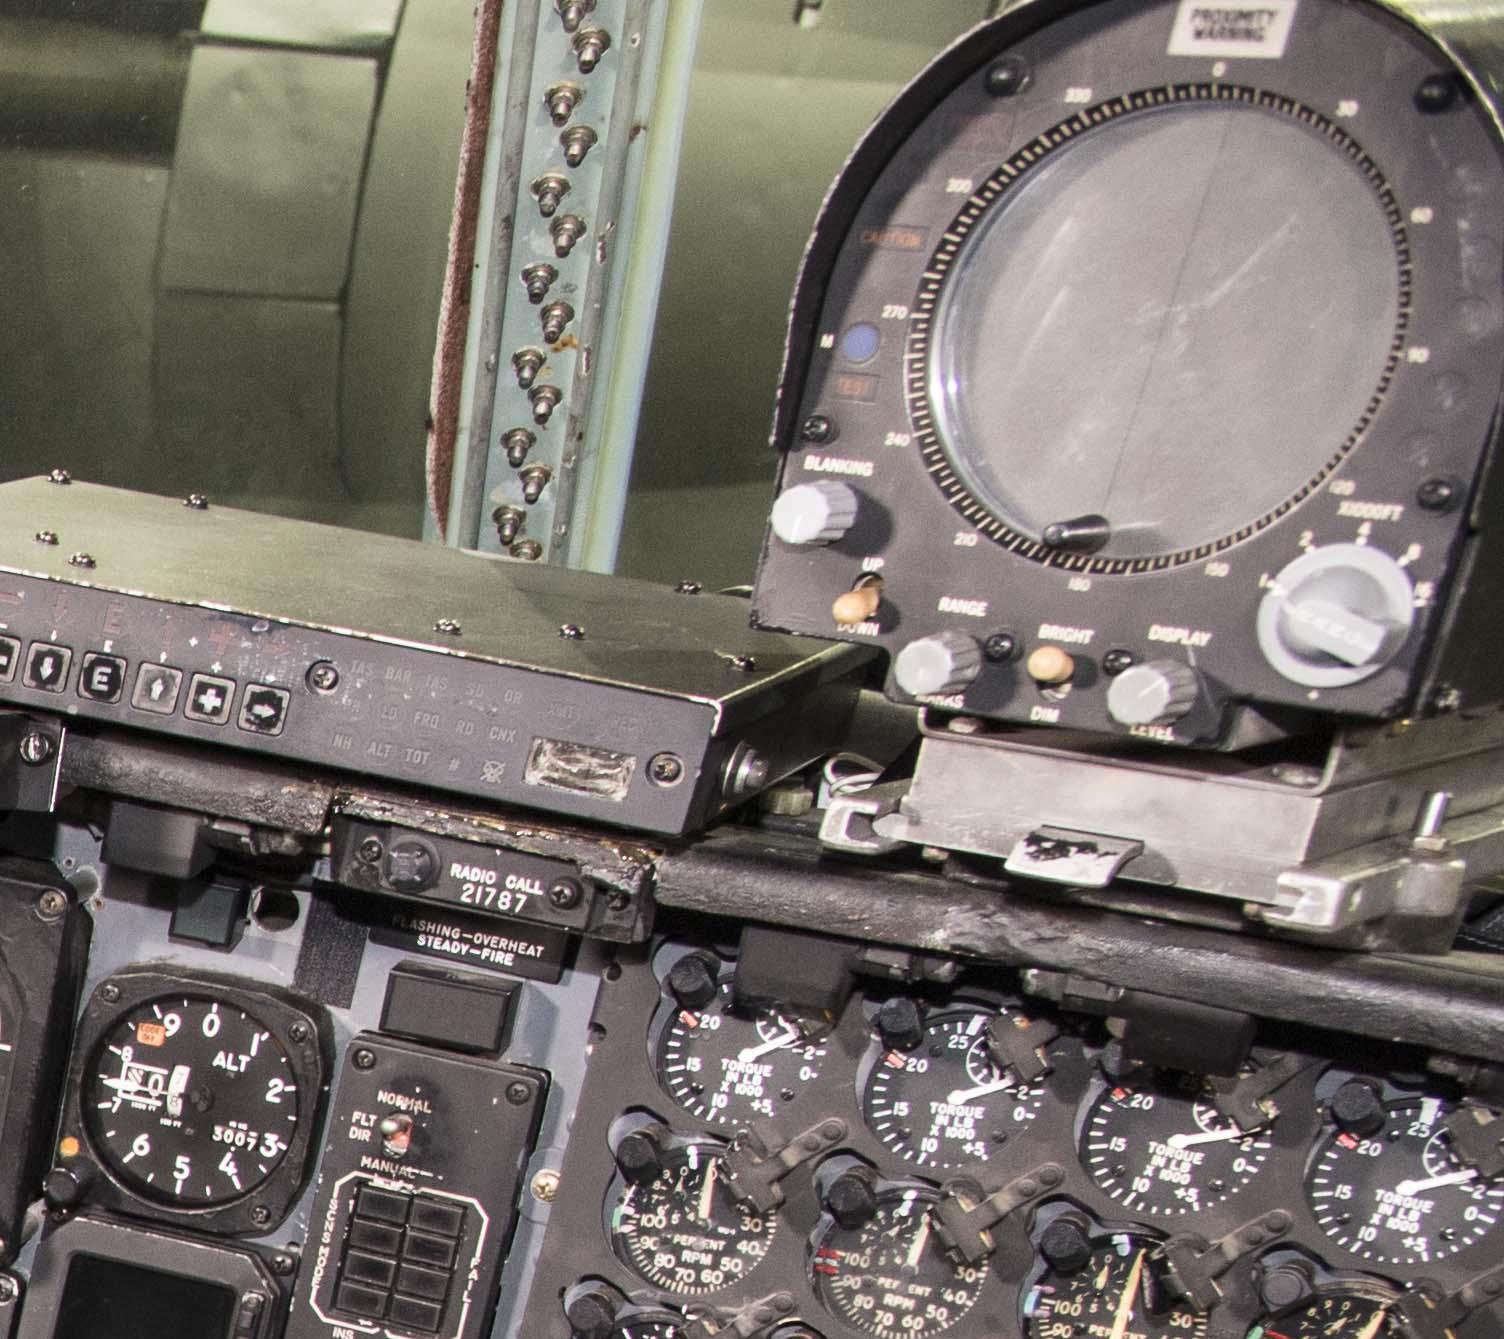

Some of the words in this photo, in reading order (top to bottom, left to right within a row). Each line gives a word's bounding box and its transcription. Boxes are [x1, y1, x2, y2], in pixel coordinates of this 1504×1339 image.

[1190, 7, 1278, 27] PROXIMITY
[1189, 25, 1266, 42] WARNING
[805, 456, 873, 477] BLANKING
[939, 598, 987, 617] RANGE
[1039, 624, 1093, 644] BRIGHT
[1149, 624, 1211, 646] DISPLAY
[450, 864, 500, 887] RADIO
[506, 875, 543, 897] CALL
[461, 883, 528, 913] 21787
[212, 1050, 251, 1073] ALT
[720, 1059, 772, 1078] TORQUE
[352, 1111, 377, 1128] FLT
[929, 1103, 984, 1120] TORQUE
[349, 1126, 371, 1143] DIR
[1148, 1141, 1205, 1166] TORQUE
[1374, 1190, 1433, 1216] TORQUE
[681, 1250, 712, 1266] RPM
